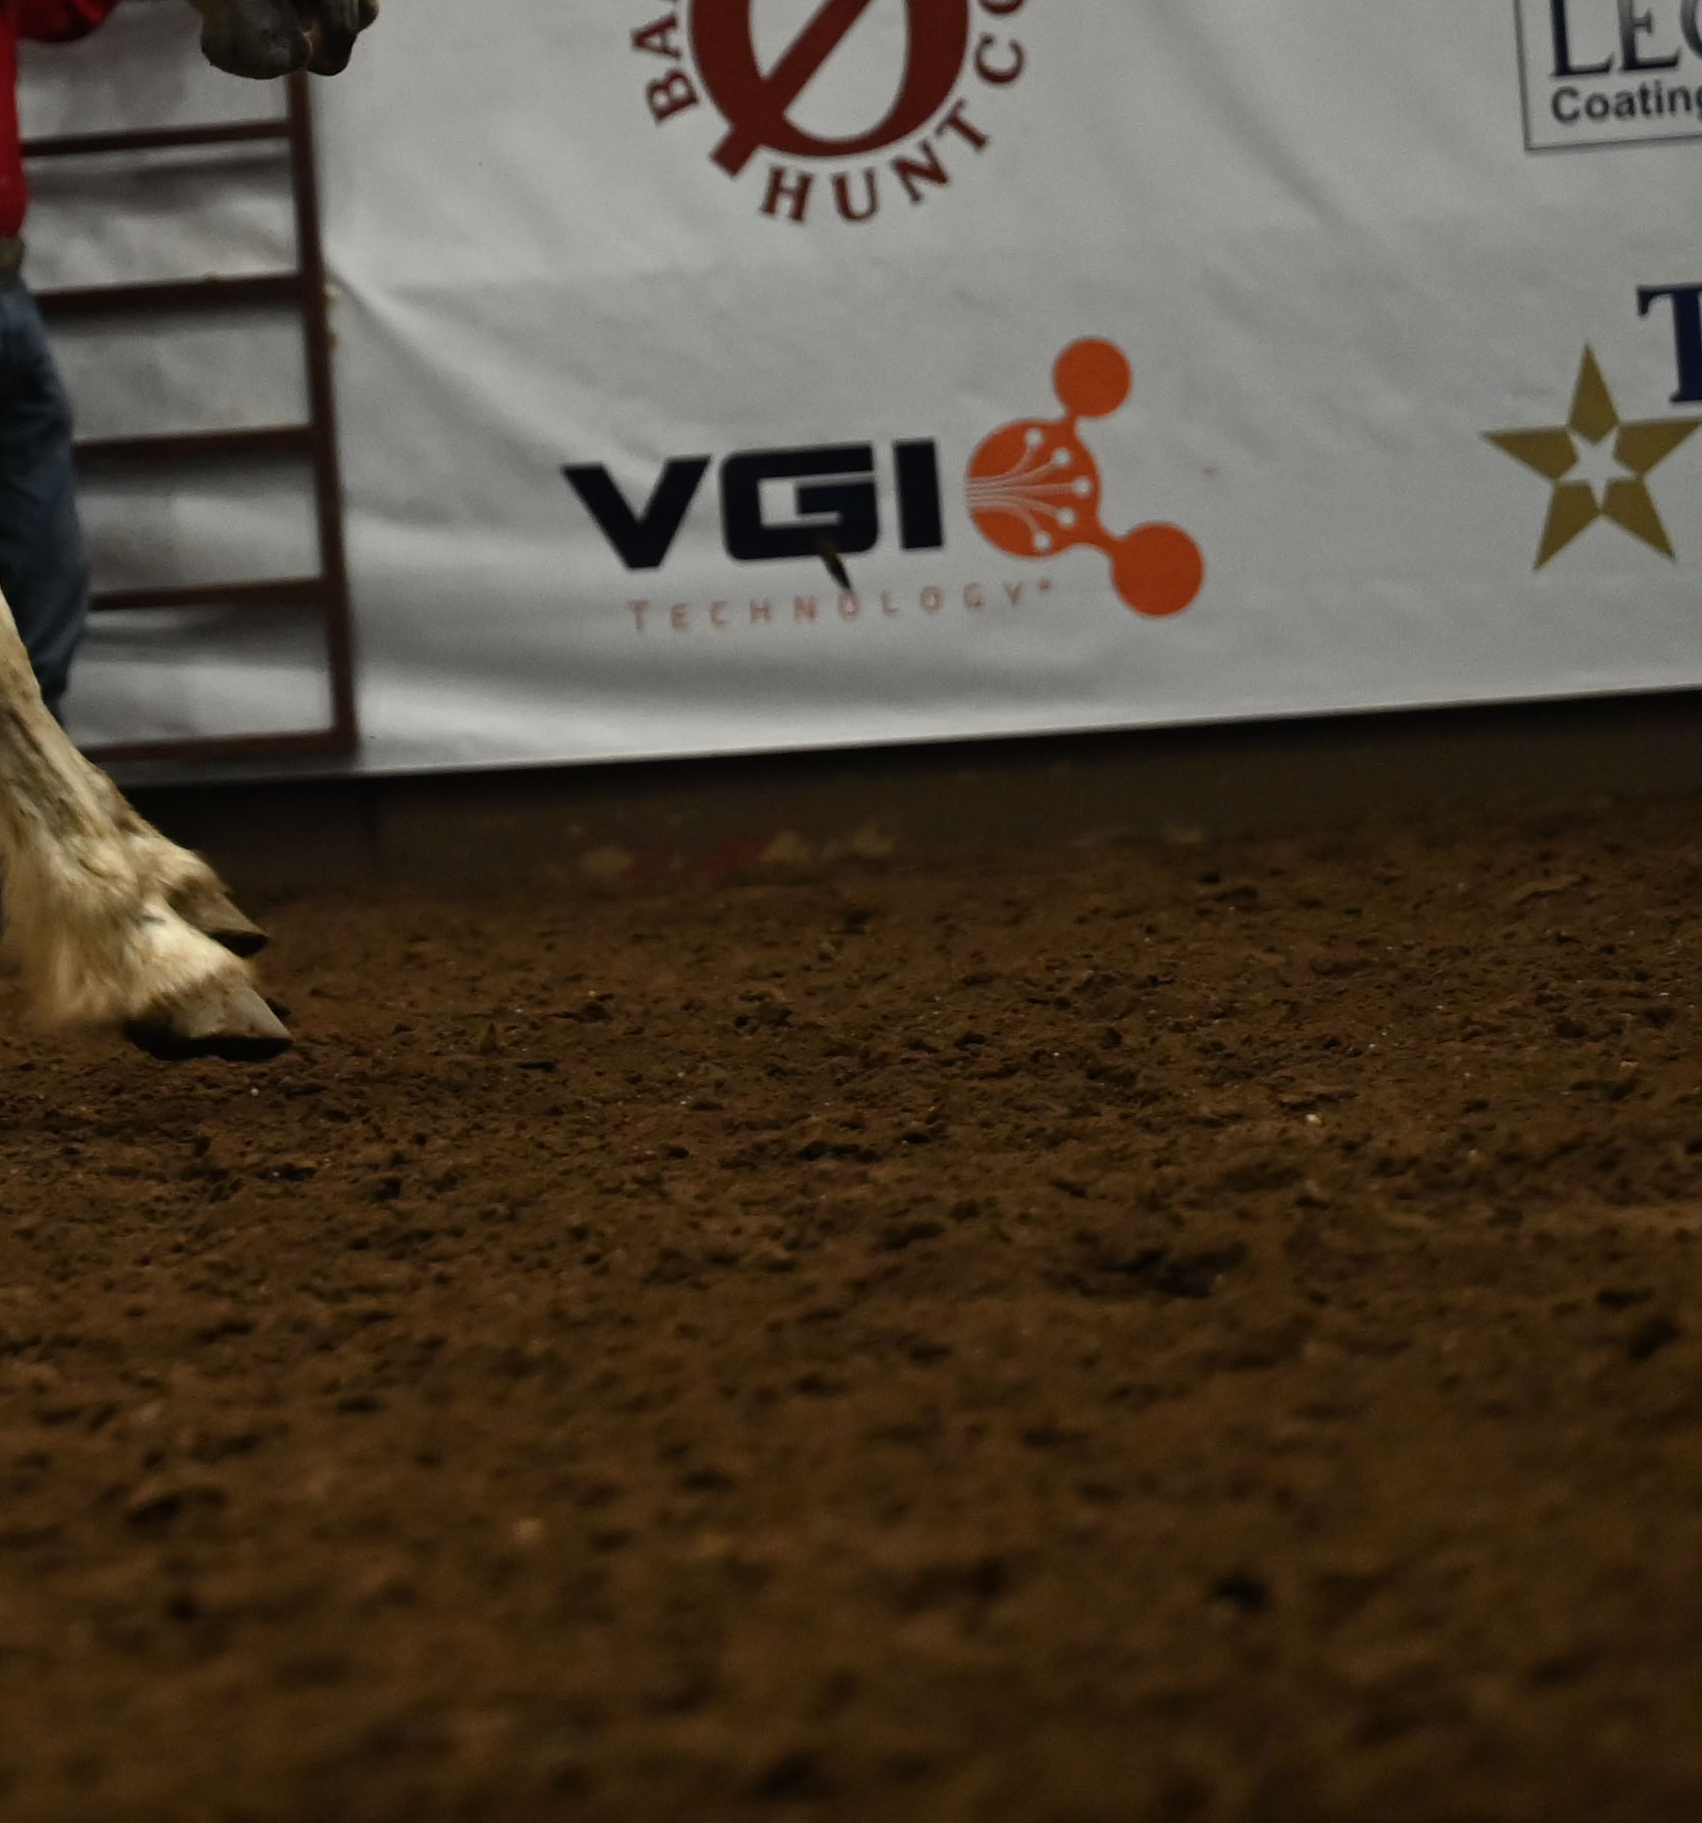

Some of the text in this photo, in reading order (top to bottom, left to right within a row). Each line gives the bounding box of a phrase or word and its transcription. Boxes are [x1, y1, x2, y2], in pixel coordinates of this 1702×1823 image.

[760, 98, 989, 222] HUNT
[1551, 79, 1702, 126] Coatin
[562, 439, 943, 569] VGI
